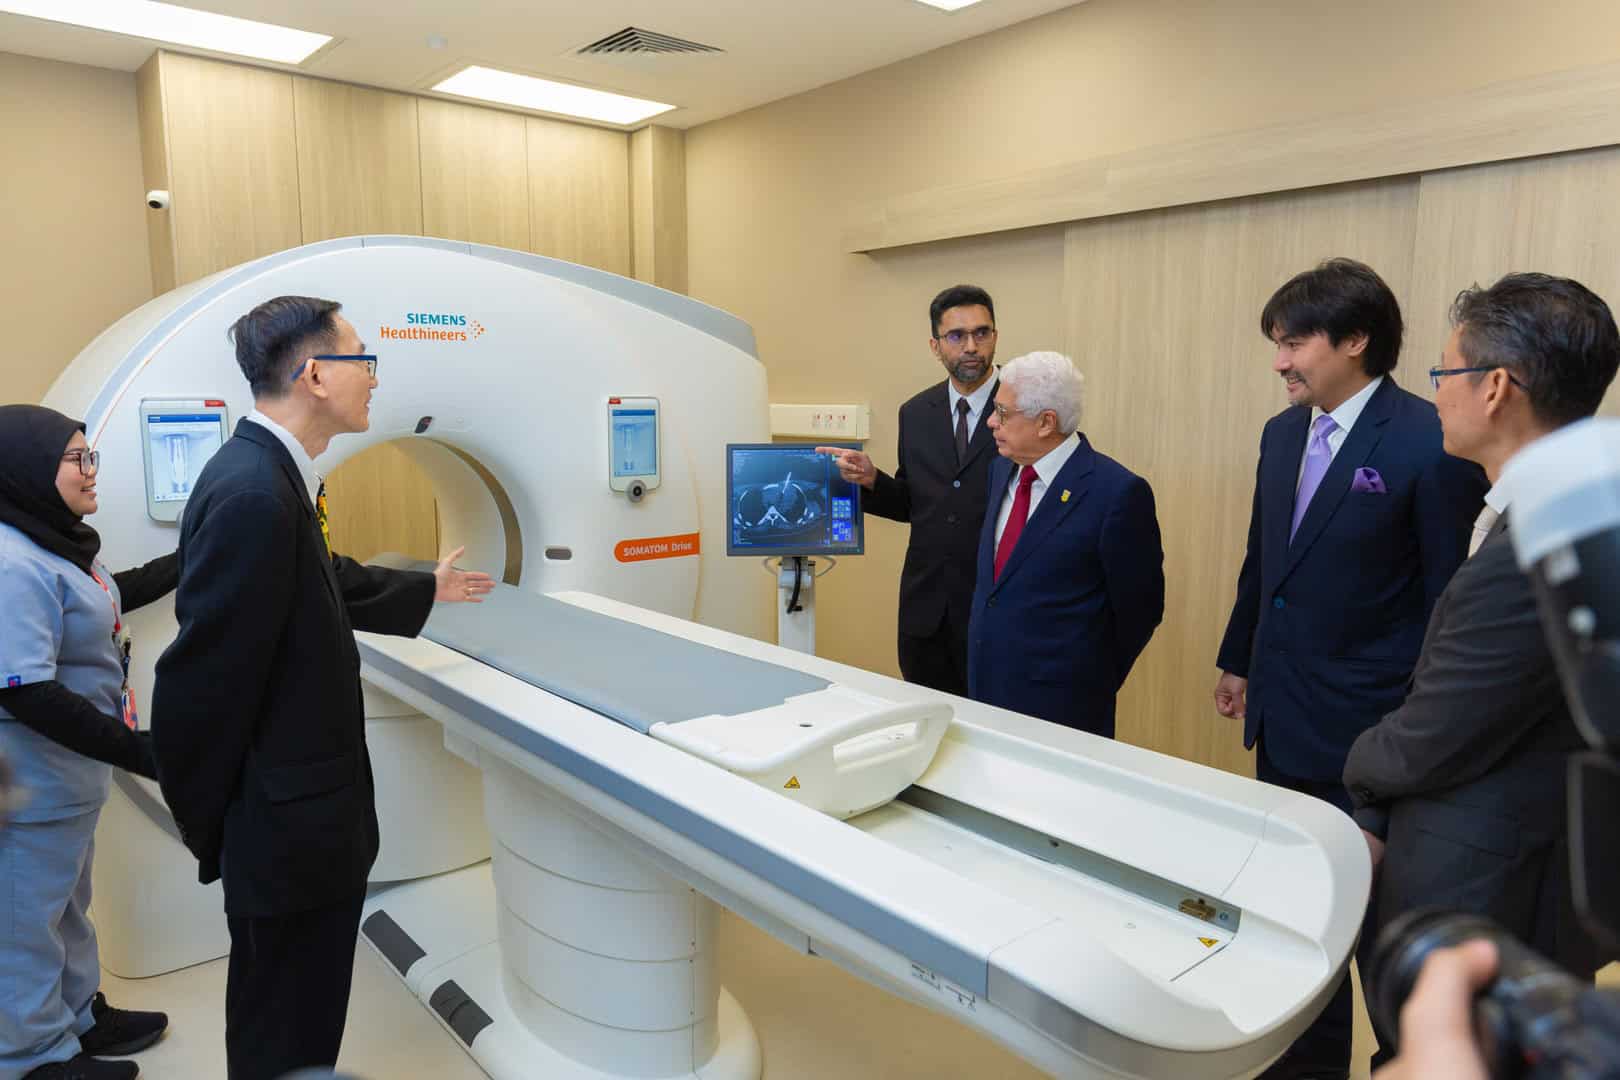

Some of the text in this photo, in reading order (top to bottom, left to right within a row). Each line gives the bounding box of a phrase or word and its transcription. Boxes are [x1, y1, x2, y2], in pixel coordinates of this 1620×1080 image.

[407, 313, 466, 325] SIEMENS
[380, 326, 467, 341] Healthineers
[623, 542, 692, 556] SOMATOM Drive
